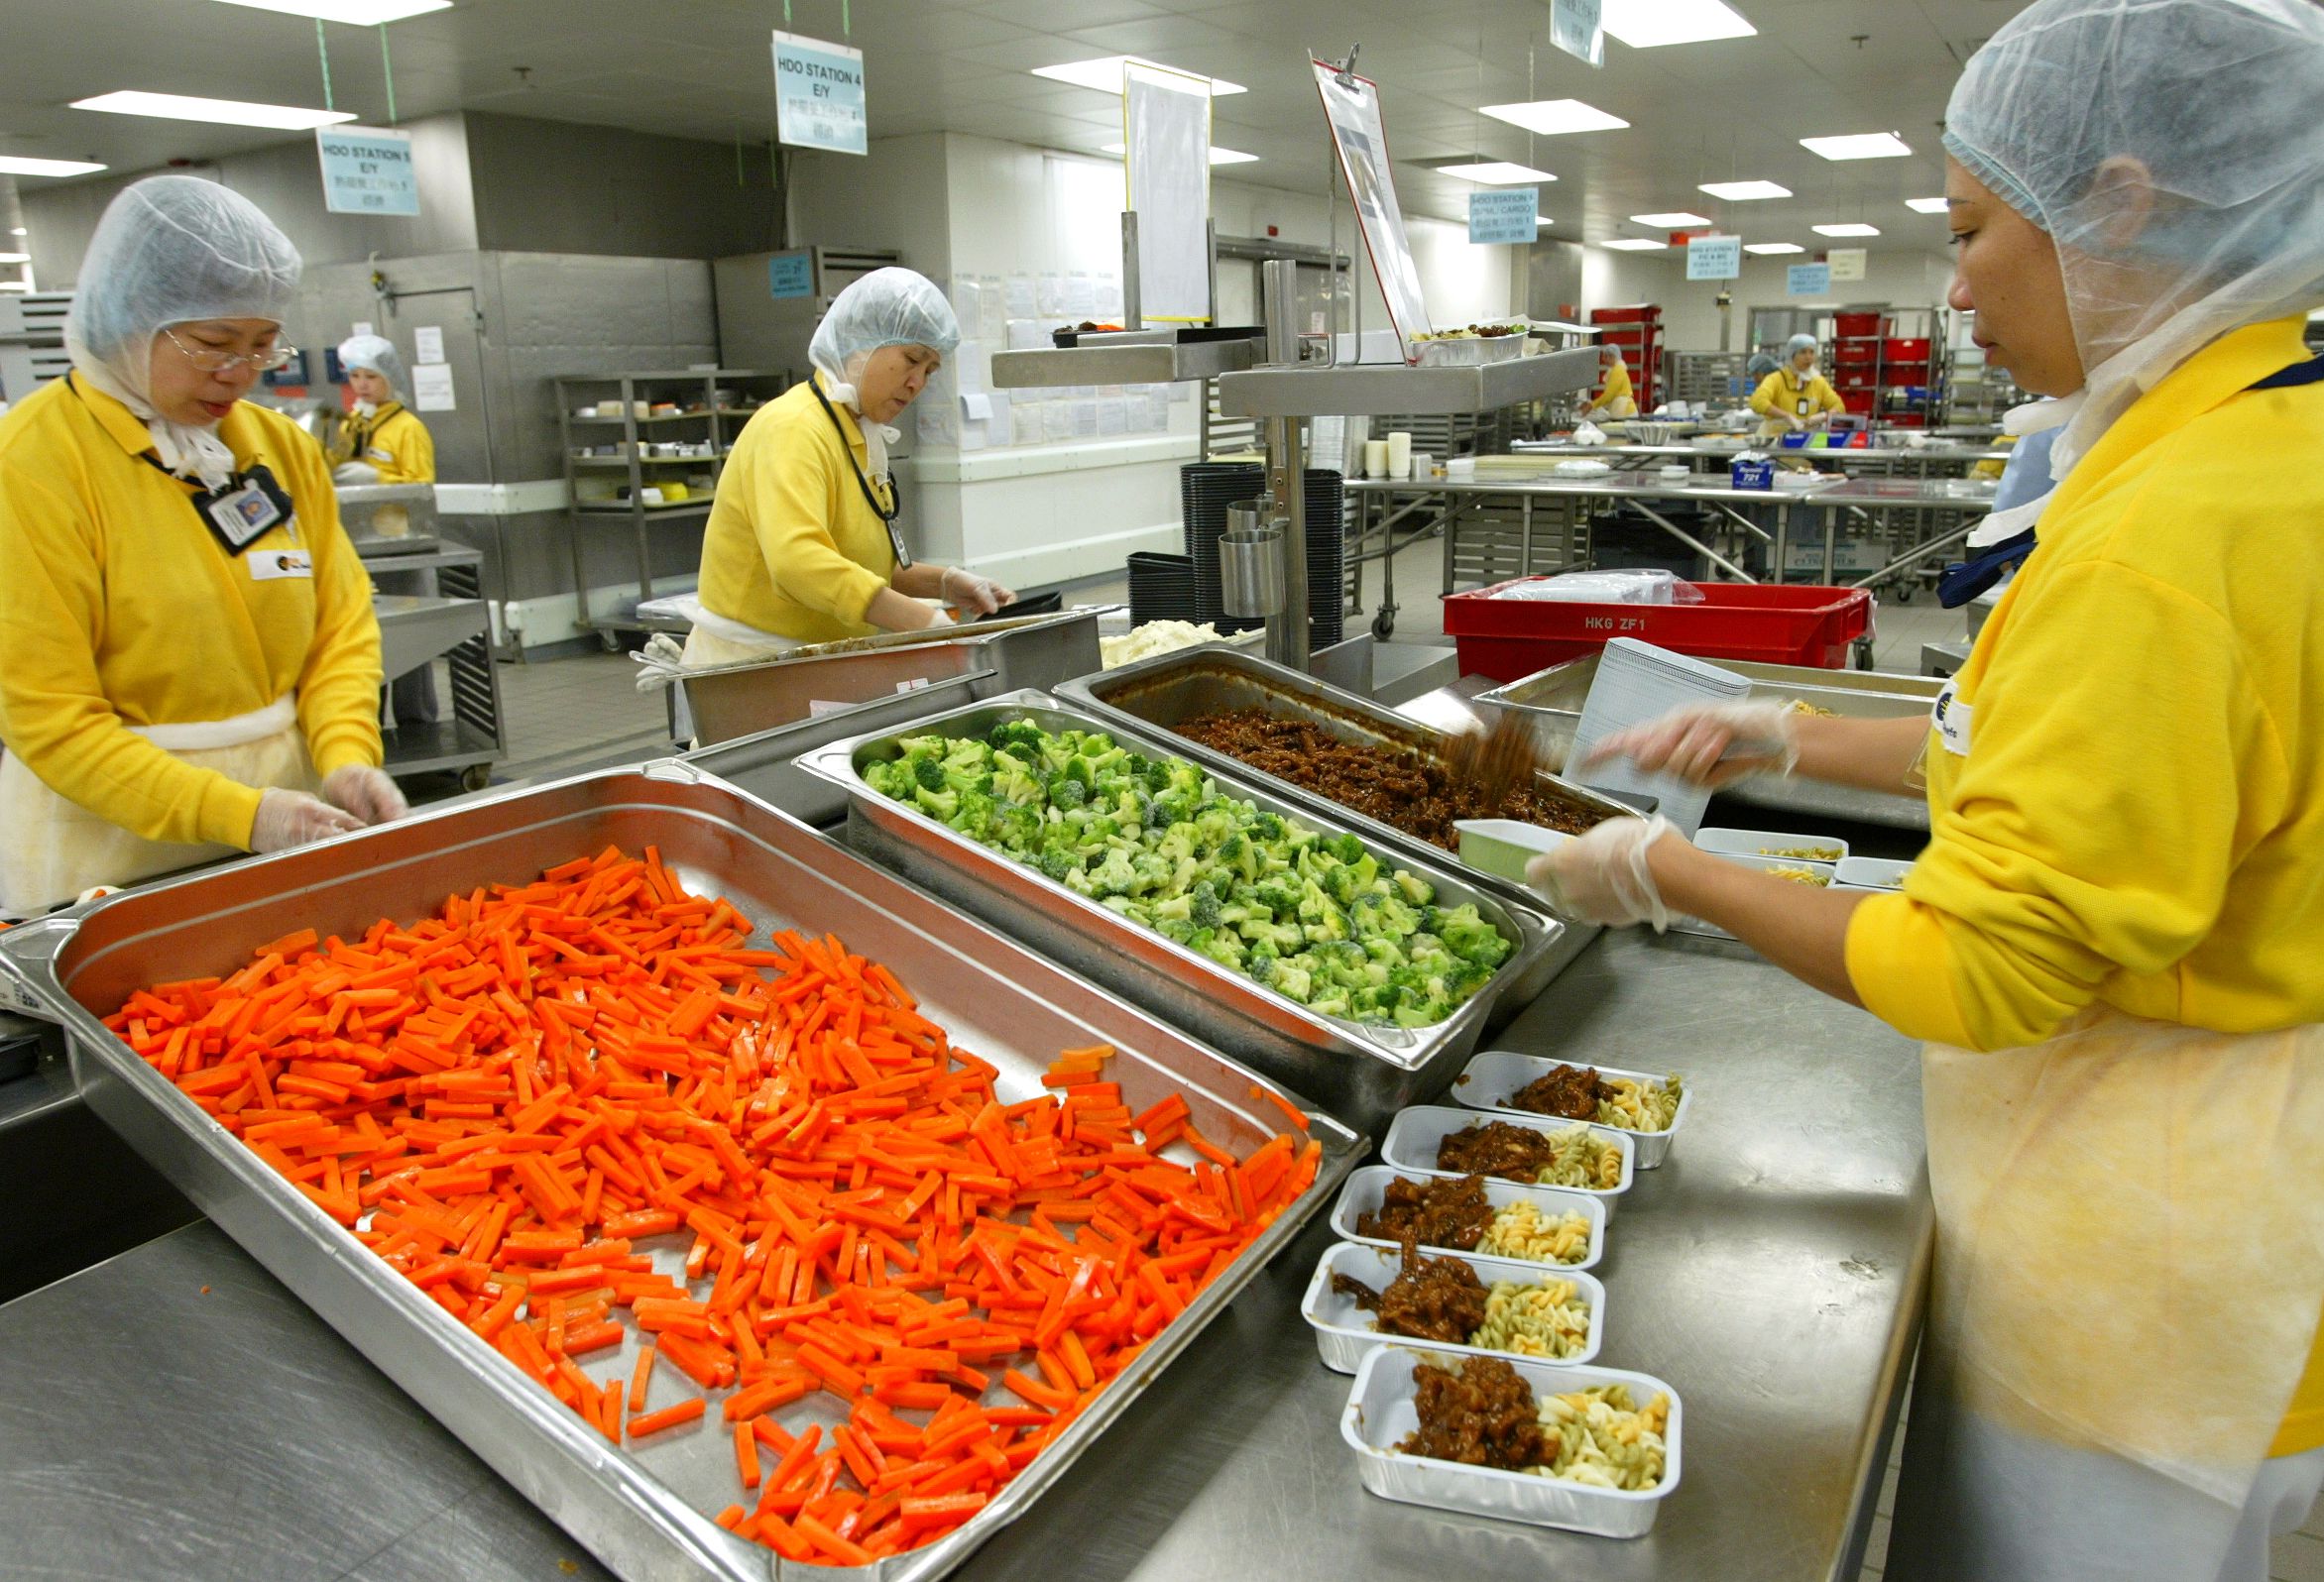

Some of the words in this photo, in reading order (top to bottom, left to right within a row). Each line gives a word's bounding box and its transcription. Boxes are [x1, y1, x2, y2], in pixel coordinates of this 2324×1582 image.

[777, 57, 803, 74] HDO
[805, 62, 853, 85] STATION
[854, 74, 862, 86] 4
[813, 83, 831, 98] E/Y
[351, 147, 403, 163] STATION
[1585, 617, 1614, 629] HKG
